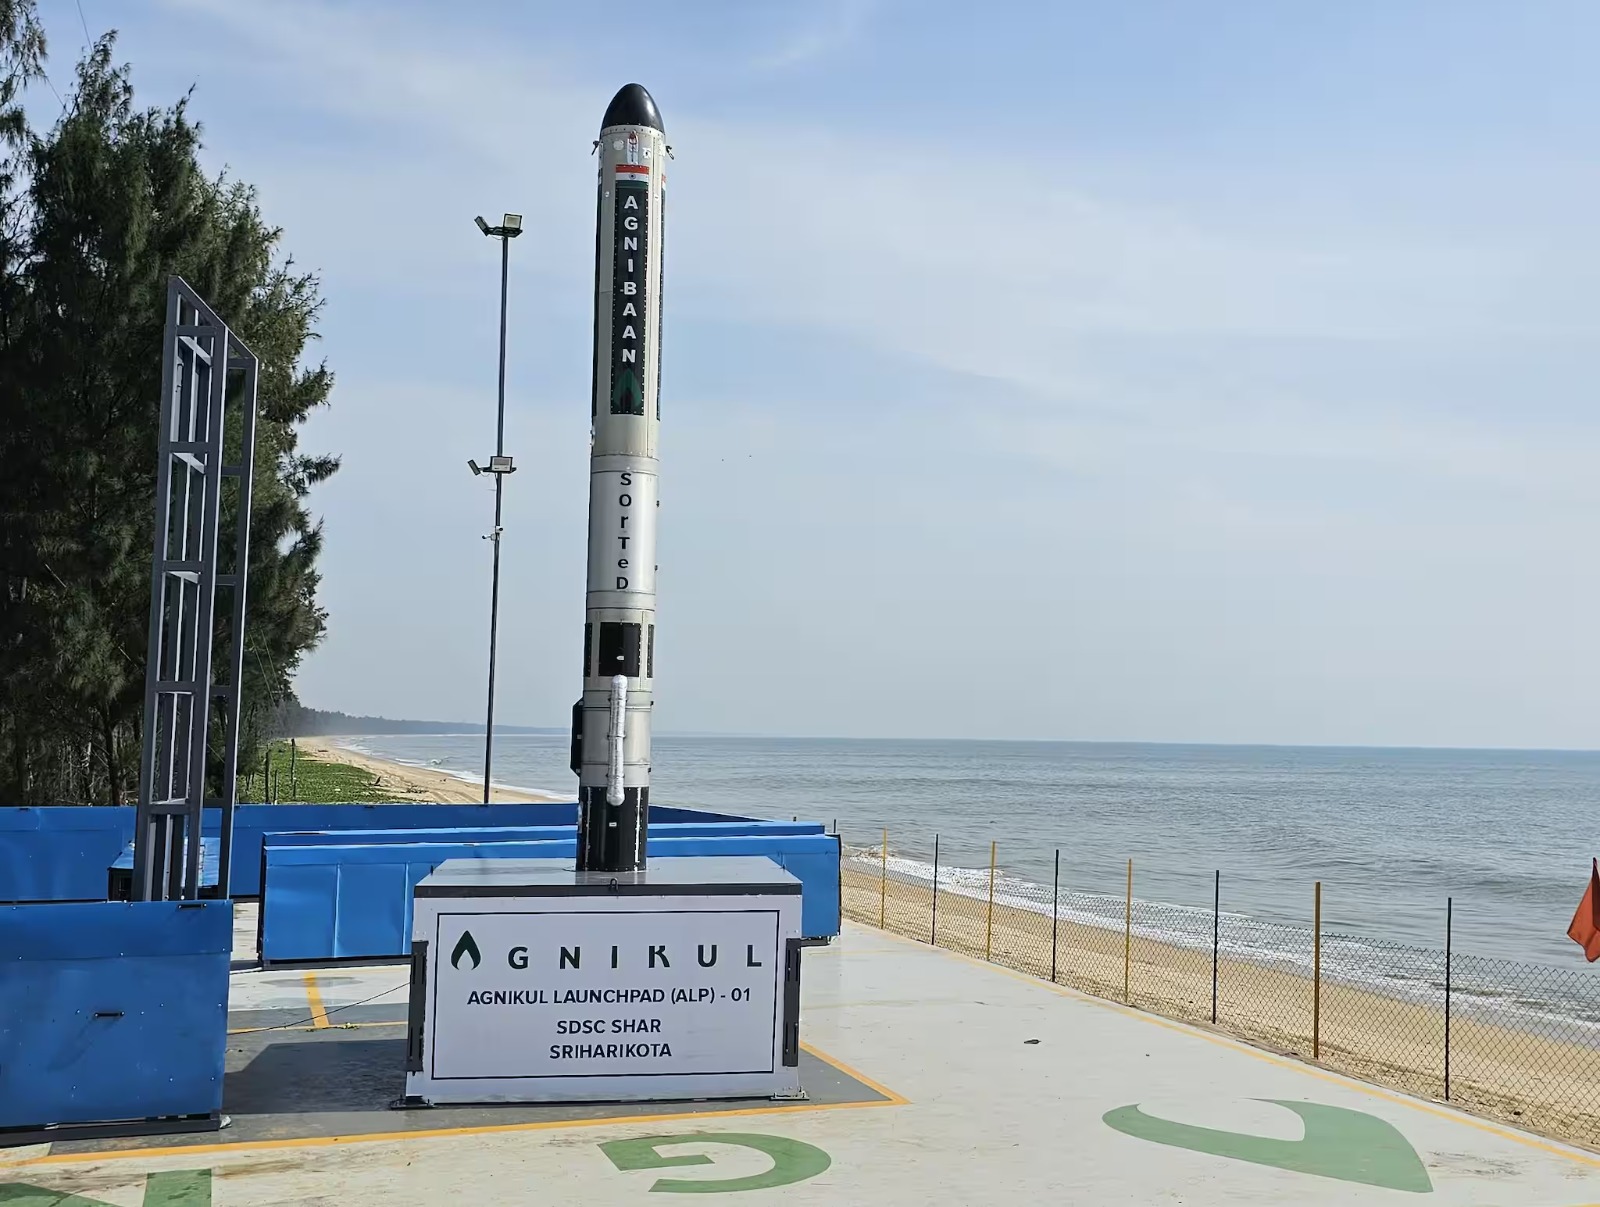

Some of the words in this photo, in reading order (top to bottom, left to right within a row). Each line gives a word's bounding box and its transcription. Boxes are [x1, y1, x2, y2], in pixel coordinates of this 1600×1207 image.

[620, 195, 639, 363] AGNIBAAN
[466, 987, 548, 1005] AGNIKUL
[553, 986, 665, 1005] LAUNCHPAD
[671, 986, 715, 1007] (ALP)
[731, 987, 751, 1003] 01
[556, 1018, 606, 1036] SDSC
[611, 1018, 661, 1035] SHAR
[549, 1043, 673, 1060] SRIHARIKOTA
